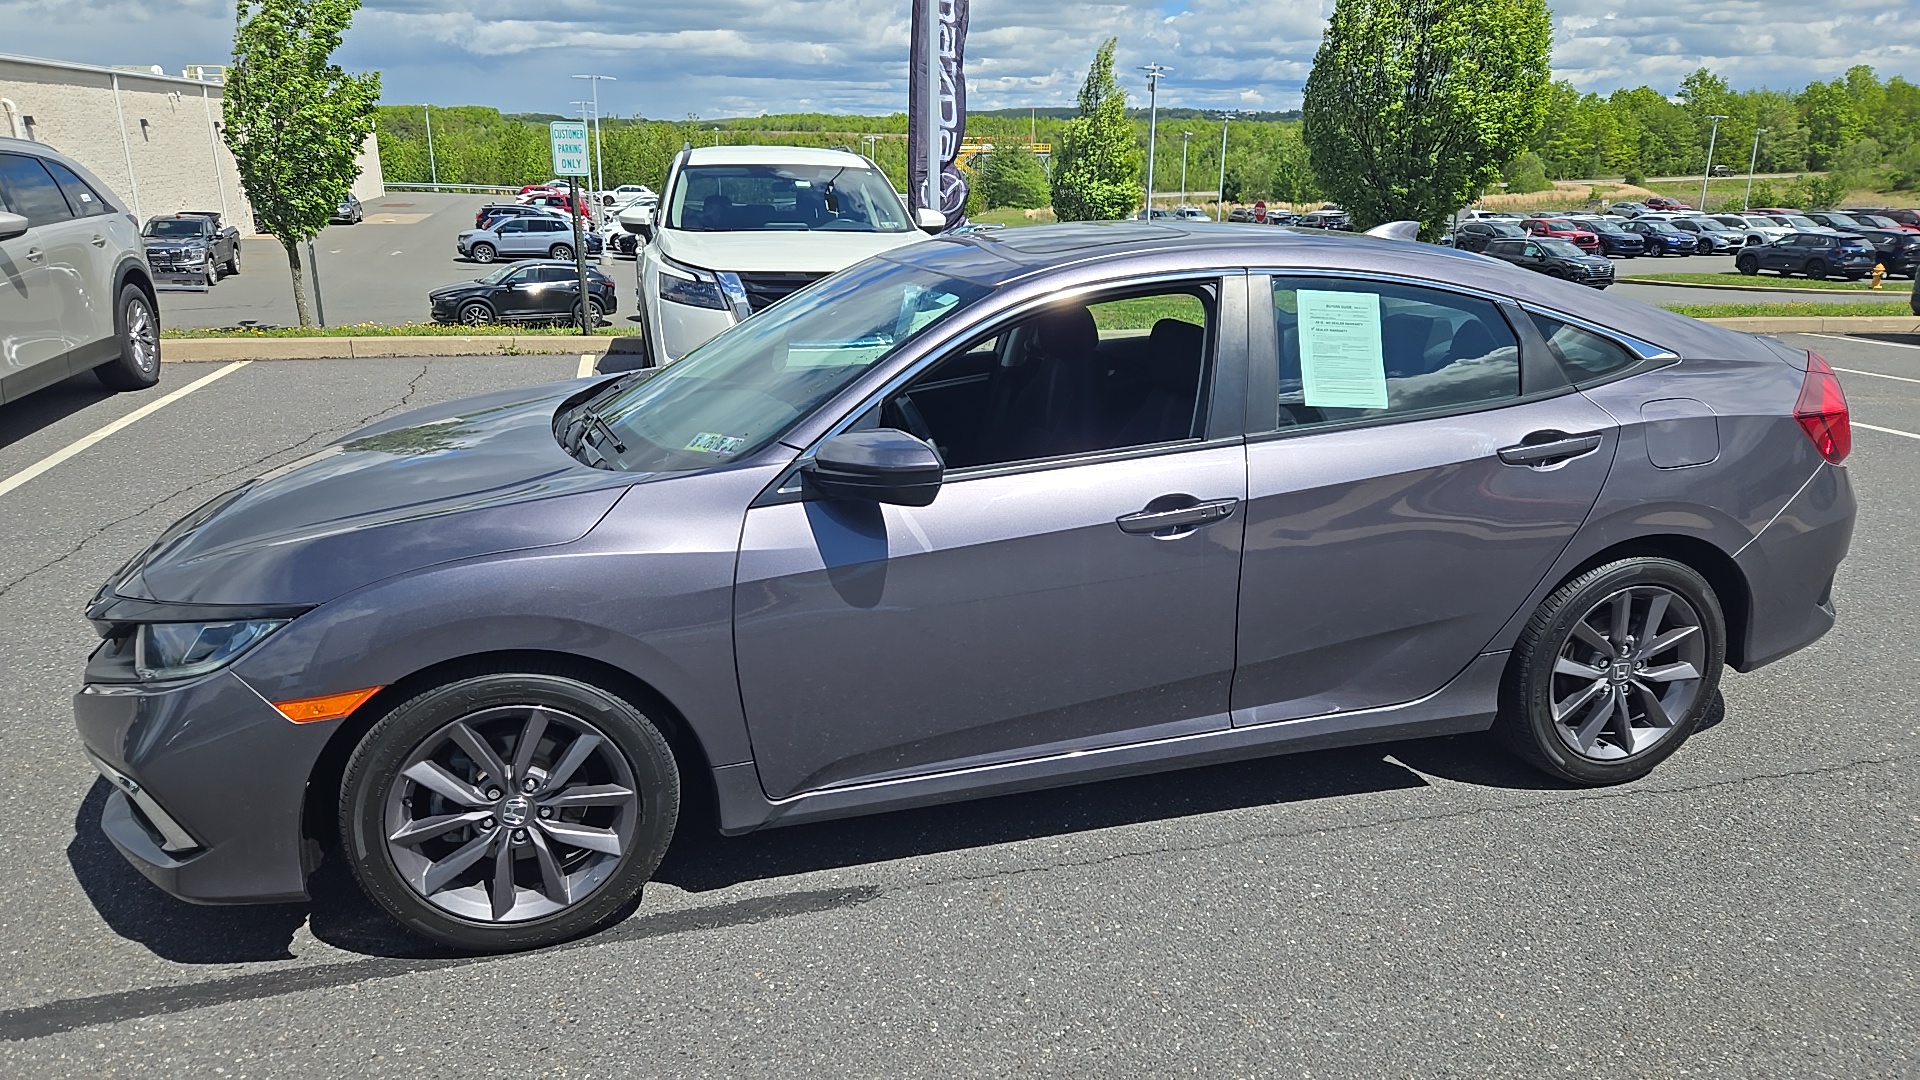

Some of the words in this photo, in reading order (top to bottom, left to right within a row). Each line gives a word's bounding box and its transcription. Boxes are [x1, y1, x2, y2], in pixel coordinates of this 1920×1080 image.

[554, 129, 584, 139] CUSTOMER
[557, 144, 582, 154] PARKING
[561, 158, 581, 169] ONLY
[1255, 206, 1266, 215] STOP
